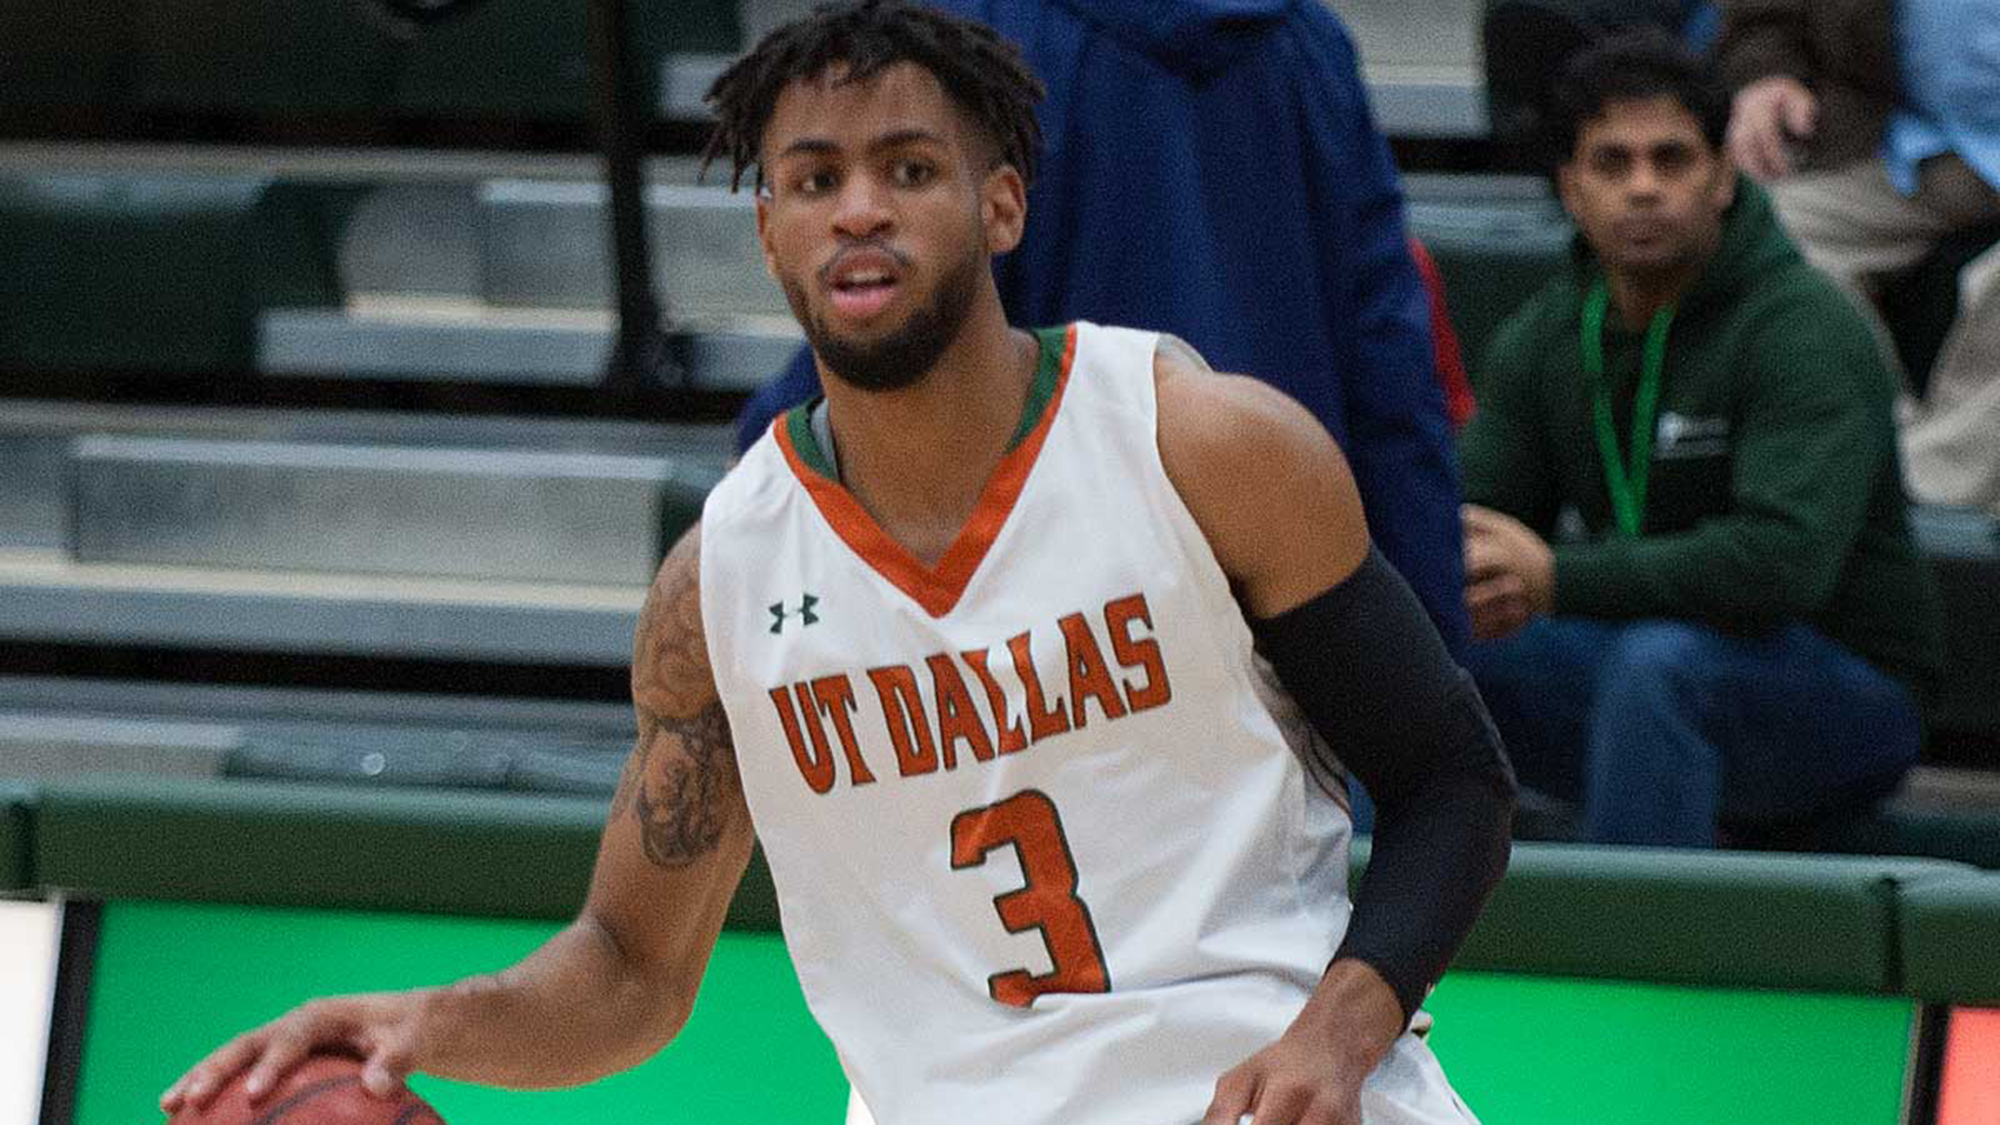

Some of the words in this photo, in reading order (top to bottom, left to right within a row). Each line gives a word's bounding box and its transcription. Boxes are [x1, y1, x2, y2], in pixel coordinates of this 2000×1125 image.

[769, 674, 877, 795] UT
[866, 592, 1172, 778] DALLAS
[949, 787, 1112, 1010] 3
